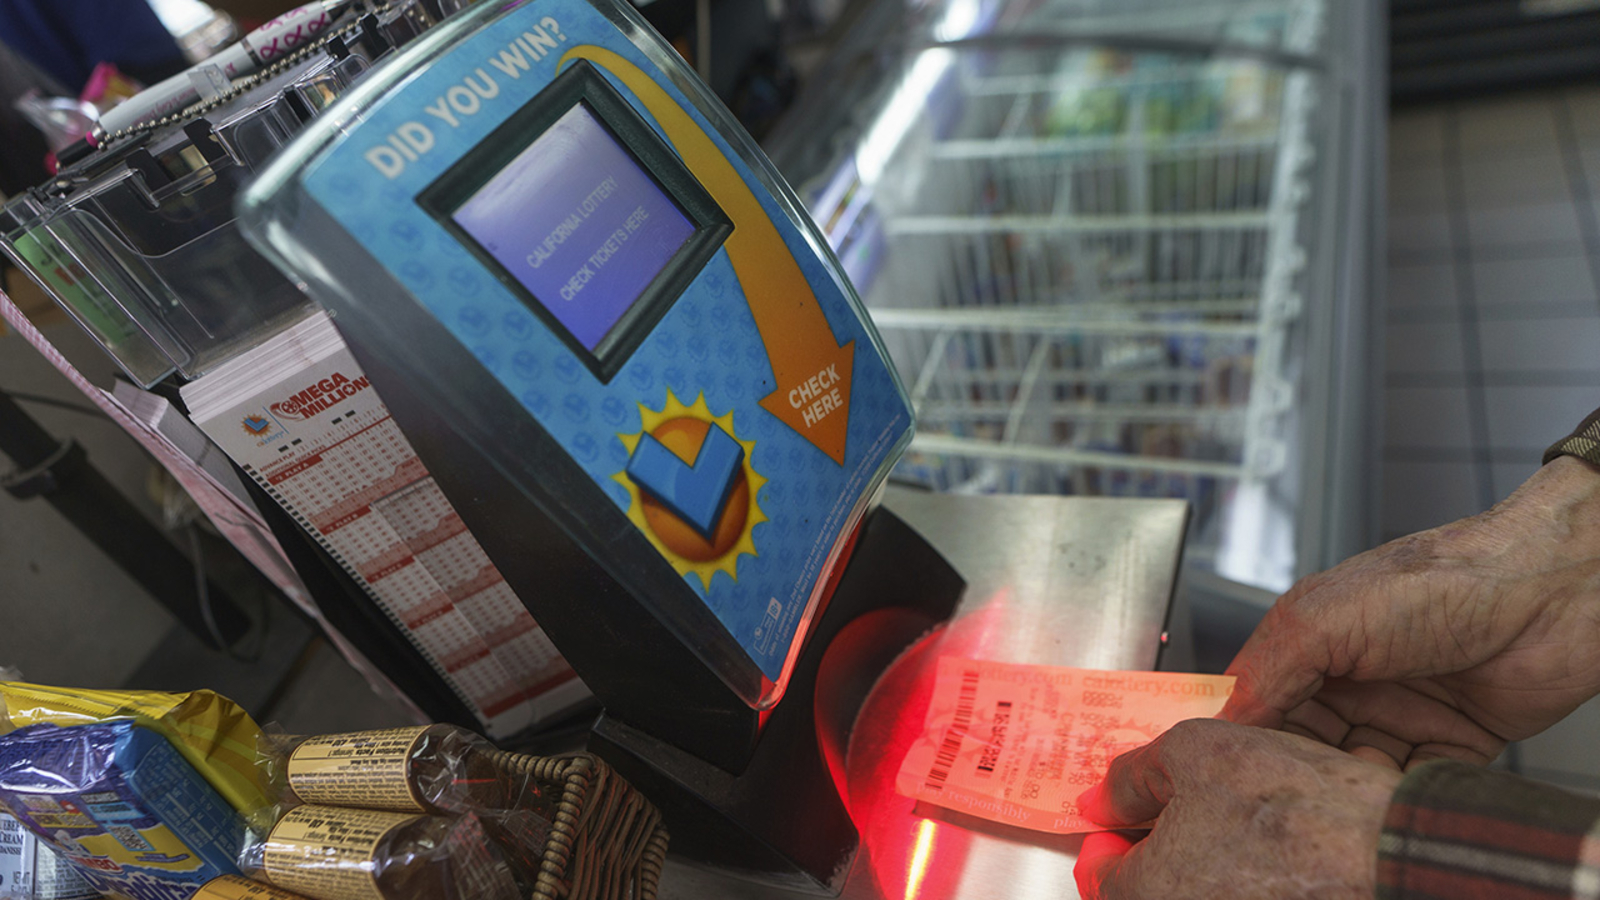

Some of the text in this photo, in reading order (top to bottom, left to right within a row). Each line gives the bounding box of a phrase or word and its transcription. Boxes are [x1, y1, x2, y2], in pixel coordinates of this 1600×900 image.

[366, 16, 567, 181] DID YOU WIN?
[526, 175, 617, 270] CALIFORNIA LOTTERY
[560, 205, 650, 303] CHECK TICKETS HERE
[291, 372, 350, 409] MEGA
[787, 363, 842, 409] CHECK
[800, 388, 845, 429] HERE
[260, 458, 282, 472] ADVANCE
[282, 452, 295, 460] PLAY
[285, 465, 302, 476] PLAY
[948, 790, 1031, 822] responsibly
[1053, 816, 1084, 830] play
